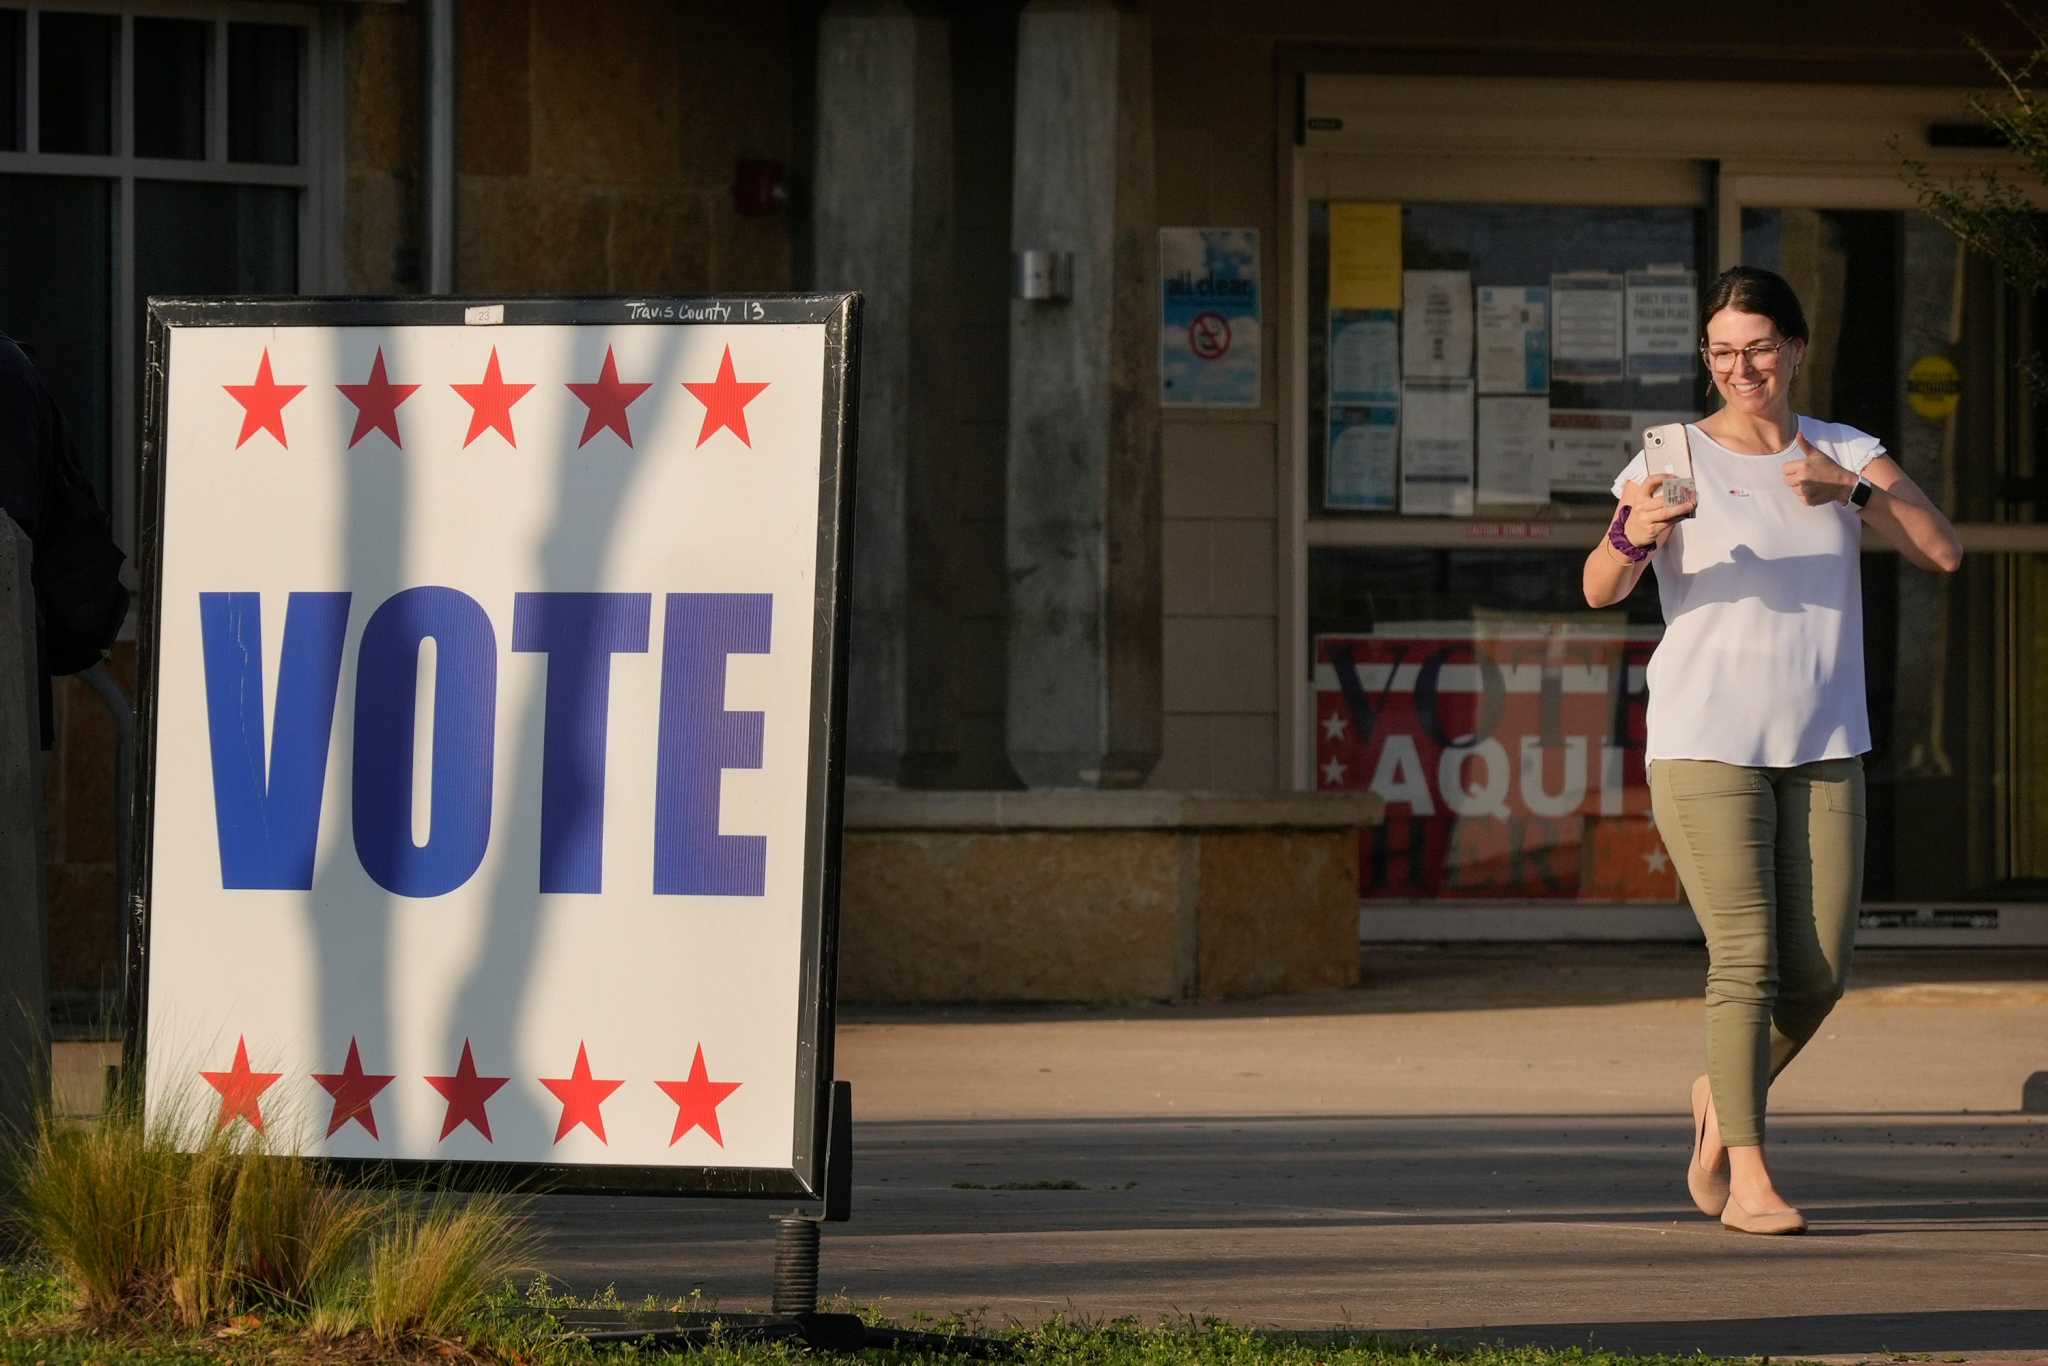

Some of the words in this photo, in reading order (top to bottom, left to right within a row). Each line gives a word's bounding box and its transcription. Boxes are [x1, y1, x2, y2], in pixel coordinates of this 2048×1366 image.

[624, 302, 674, 321] Travis
[678, 301, 731, 323] County
[743, 301, 765, 321] 13
[198, 585, 774, 898] VOTE
